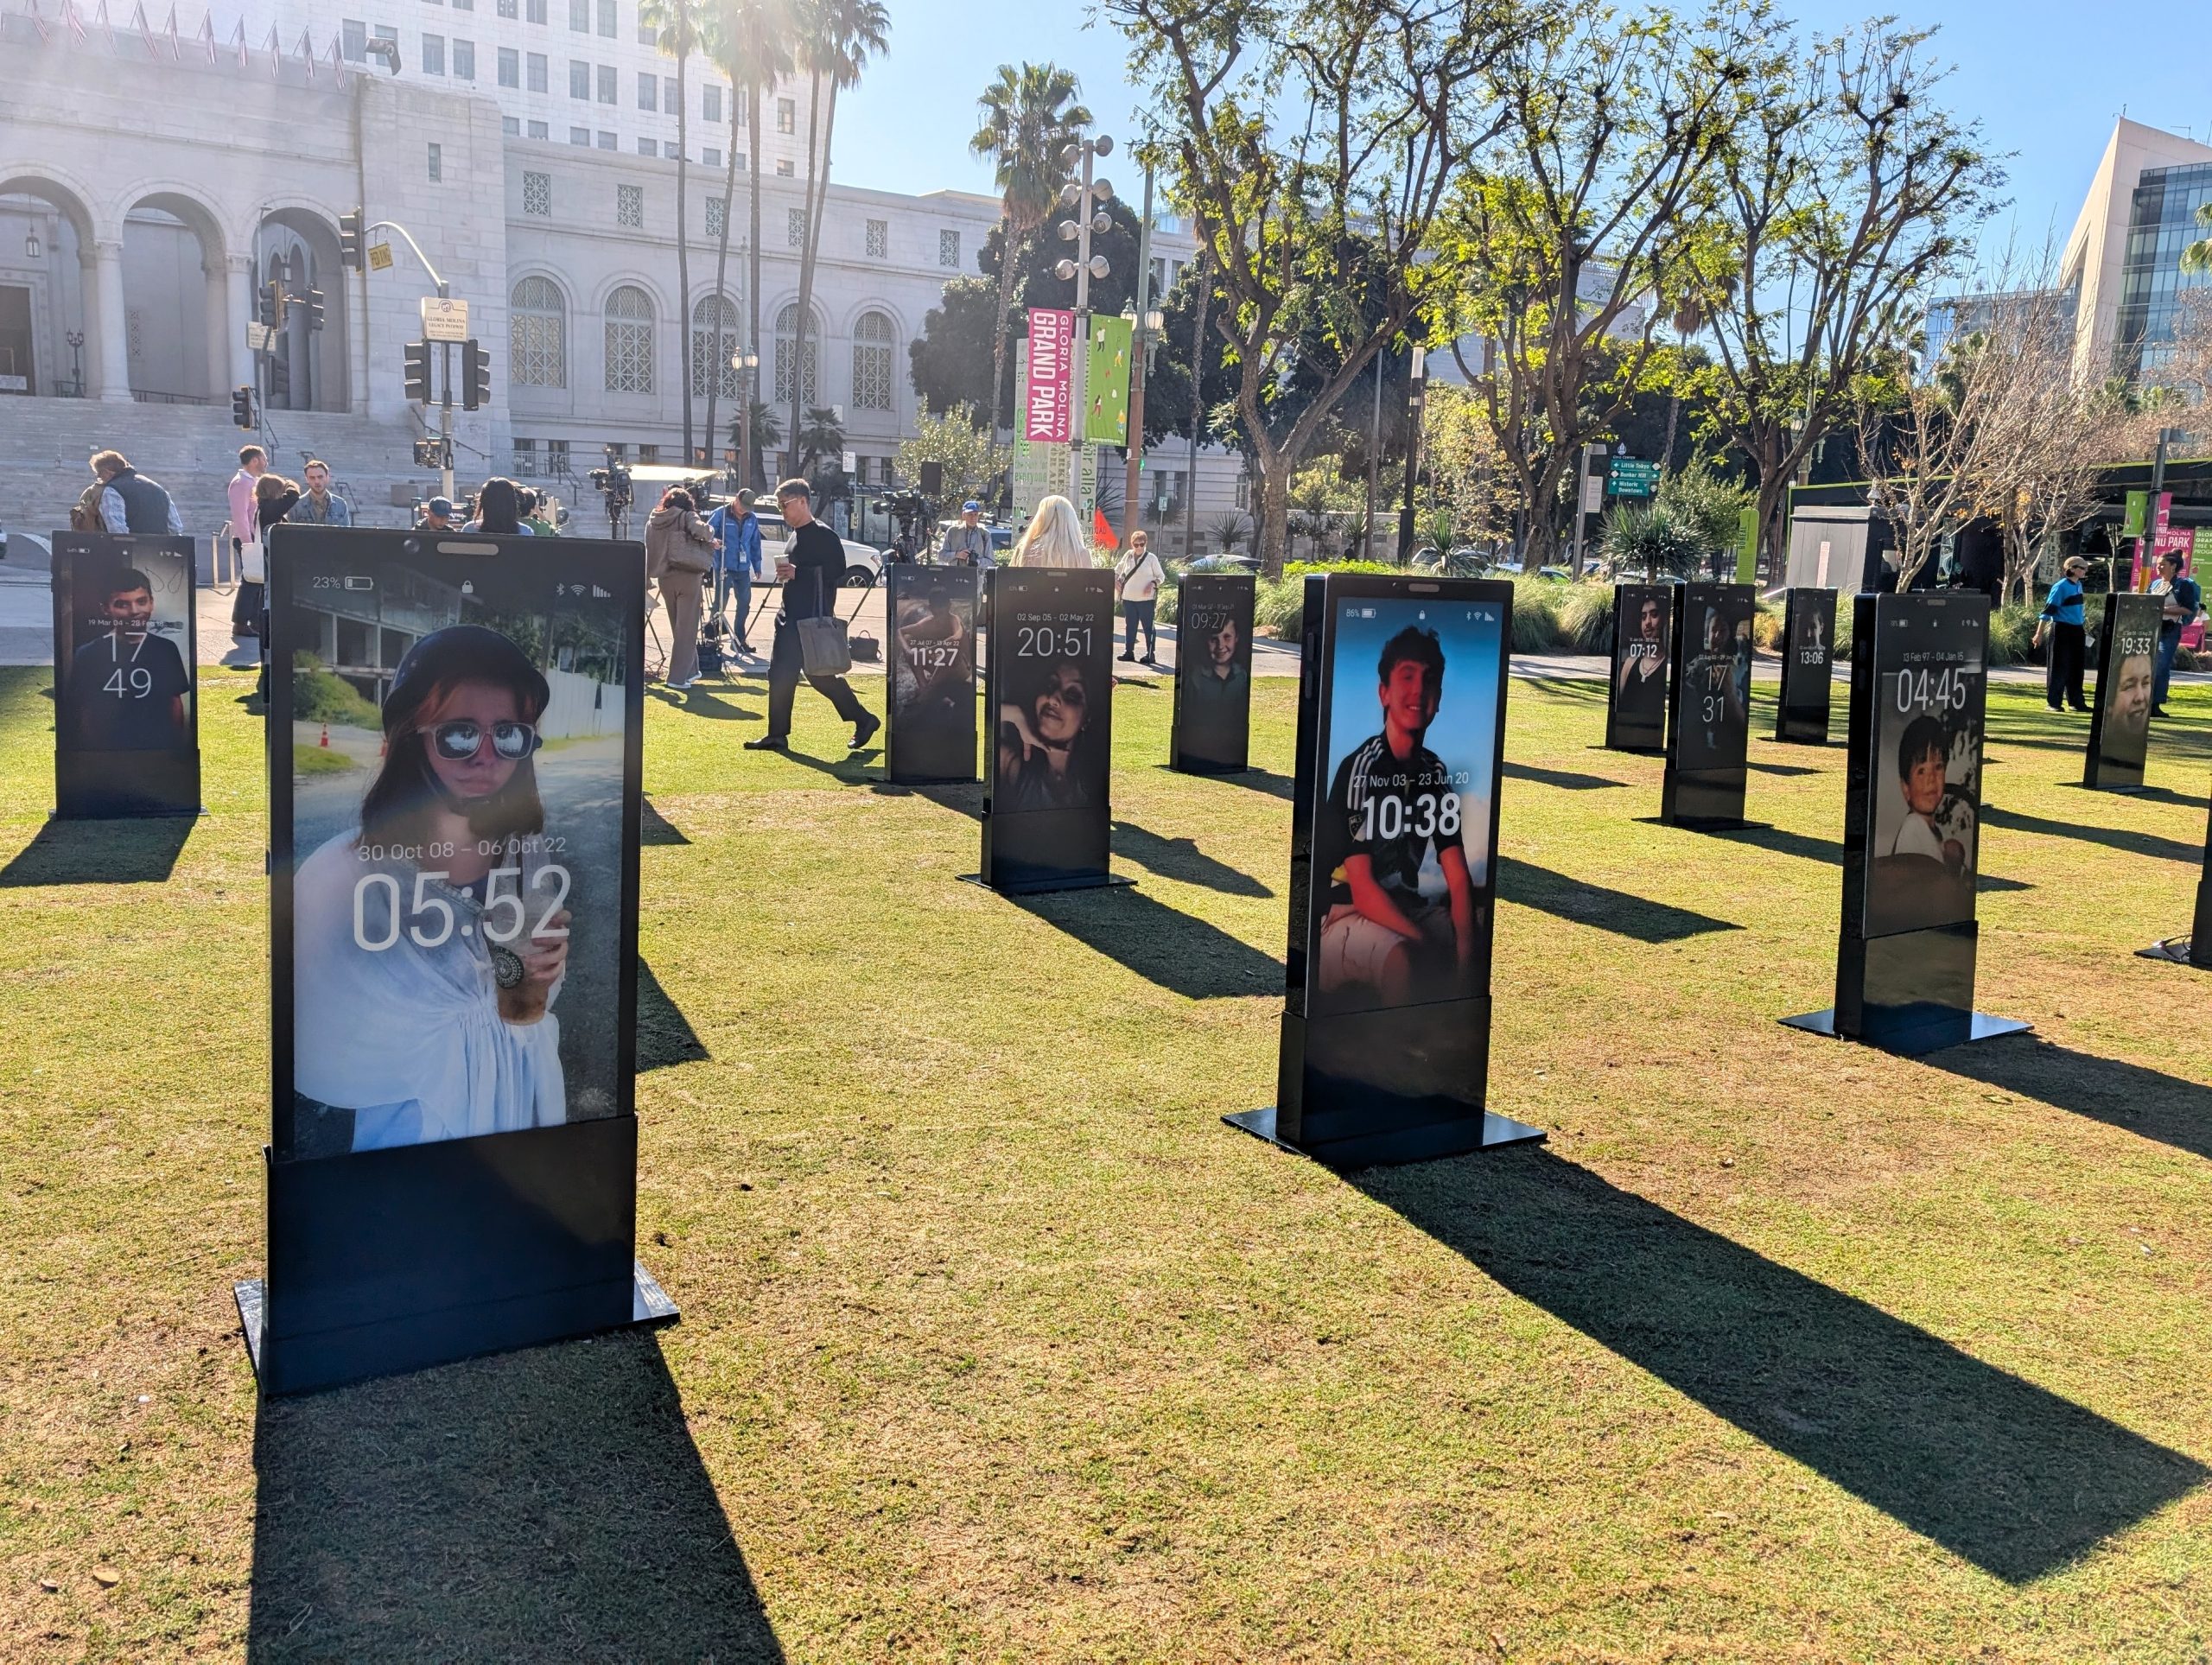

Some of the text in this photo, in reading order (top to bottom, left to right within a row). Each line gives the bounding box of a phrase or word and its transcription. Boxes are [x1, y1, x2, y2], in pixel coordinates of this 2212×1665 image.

[1029, 312, 1057, 438] GRAND PARK
[1056, 315, 1069, 438] GLORIA MOLINA
[2168, 537, 2190, 548] PARK
[313, 576, 340, 589] 23%
[1028, 613, 1040, 622] Sep
[1070, 613, 1084, 623] May
[1192, 613, 1227, 629] 09:27
[1346, 608, 1360, 618] 86%
[103, 632, 148, 663] 17
[1017, 627, 1091, 657] 20:51
[1630, 644, 1657, 658] 07:12
[2121, 637, 2151, 655] 19:33
[910, 647, 958, 666] 11:27
[1800, 651, 1824, 664] 13:06
[1910, 652, 1922, 662] Feb
[1923, 652, 1930, 661] 97
[1936, 651, 1944, 661] 04
[1946, 651, 1956, 661] Jan
[103, 668, 152, 699] 49
[1705, 664, 1727, 691] 17
[1897, 667, 1966, 713] 04:45
[1702, 696, 1724, 722] 31
[1354, 776, 1367, 788] 27
[1370, 775, 1389, 787] Nov
[1392, 774, 1407, 786] 03
[1419, 773, 1432, 785] 23
[1434, 772, 1452, 785] Jun
[1455, 772, 1469, 784] 20
[1363, 792, 1460, 841] 10:38
[359, 845, 384, 862] 30
[391, 843, 423, 861] Oct
[430, 842, 454, 859] 08
[478, 840, 502, 857] 06
[508, 838, 541, 855] Oct
[545, 836, 567, 854] 22
[353, 864, 570, 952] 05:52
